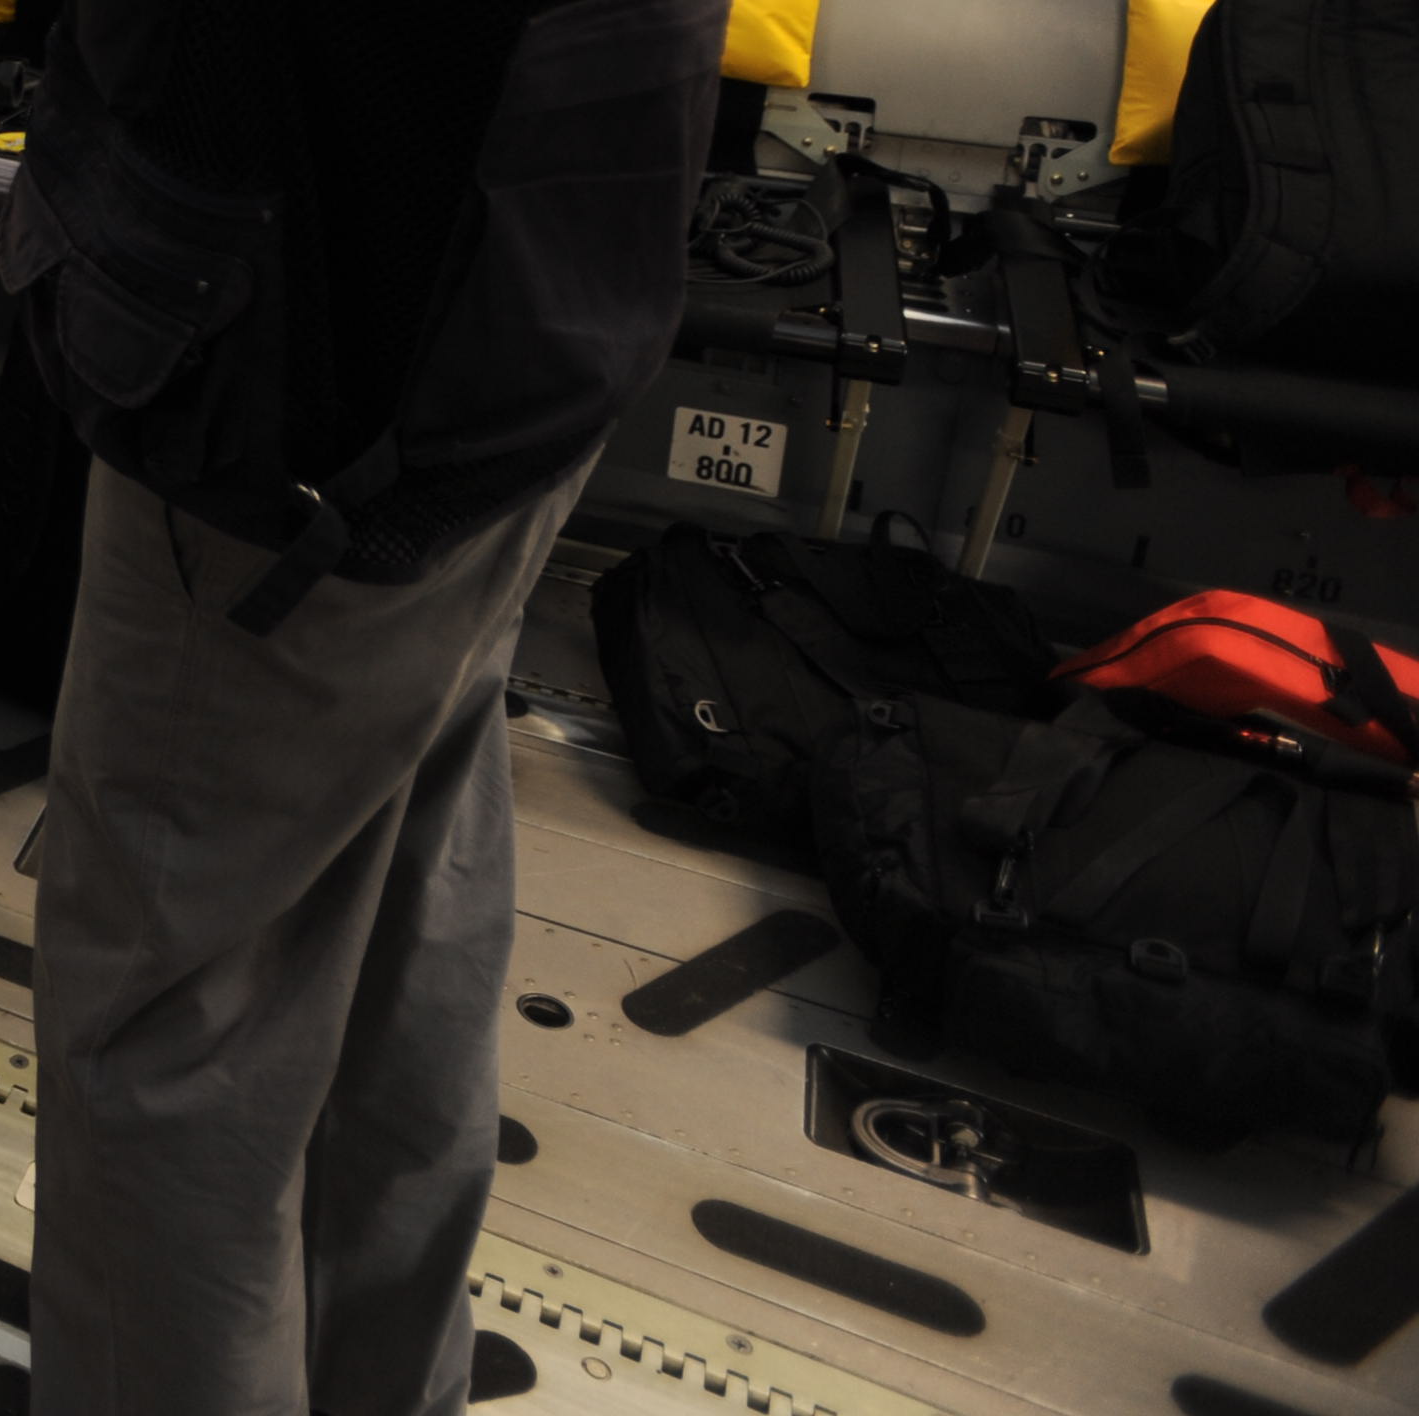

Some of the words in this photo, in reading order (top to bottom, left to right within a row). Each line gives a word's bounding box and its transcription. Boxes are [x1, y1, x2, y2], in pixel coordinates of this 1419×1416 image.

[688, 413, 726, 440] AD
[740, 421, 773, 449] 12
[696, 455, 753, 488] 800
[1272, 568, 1344, 604] 820
